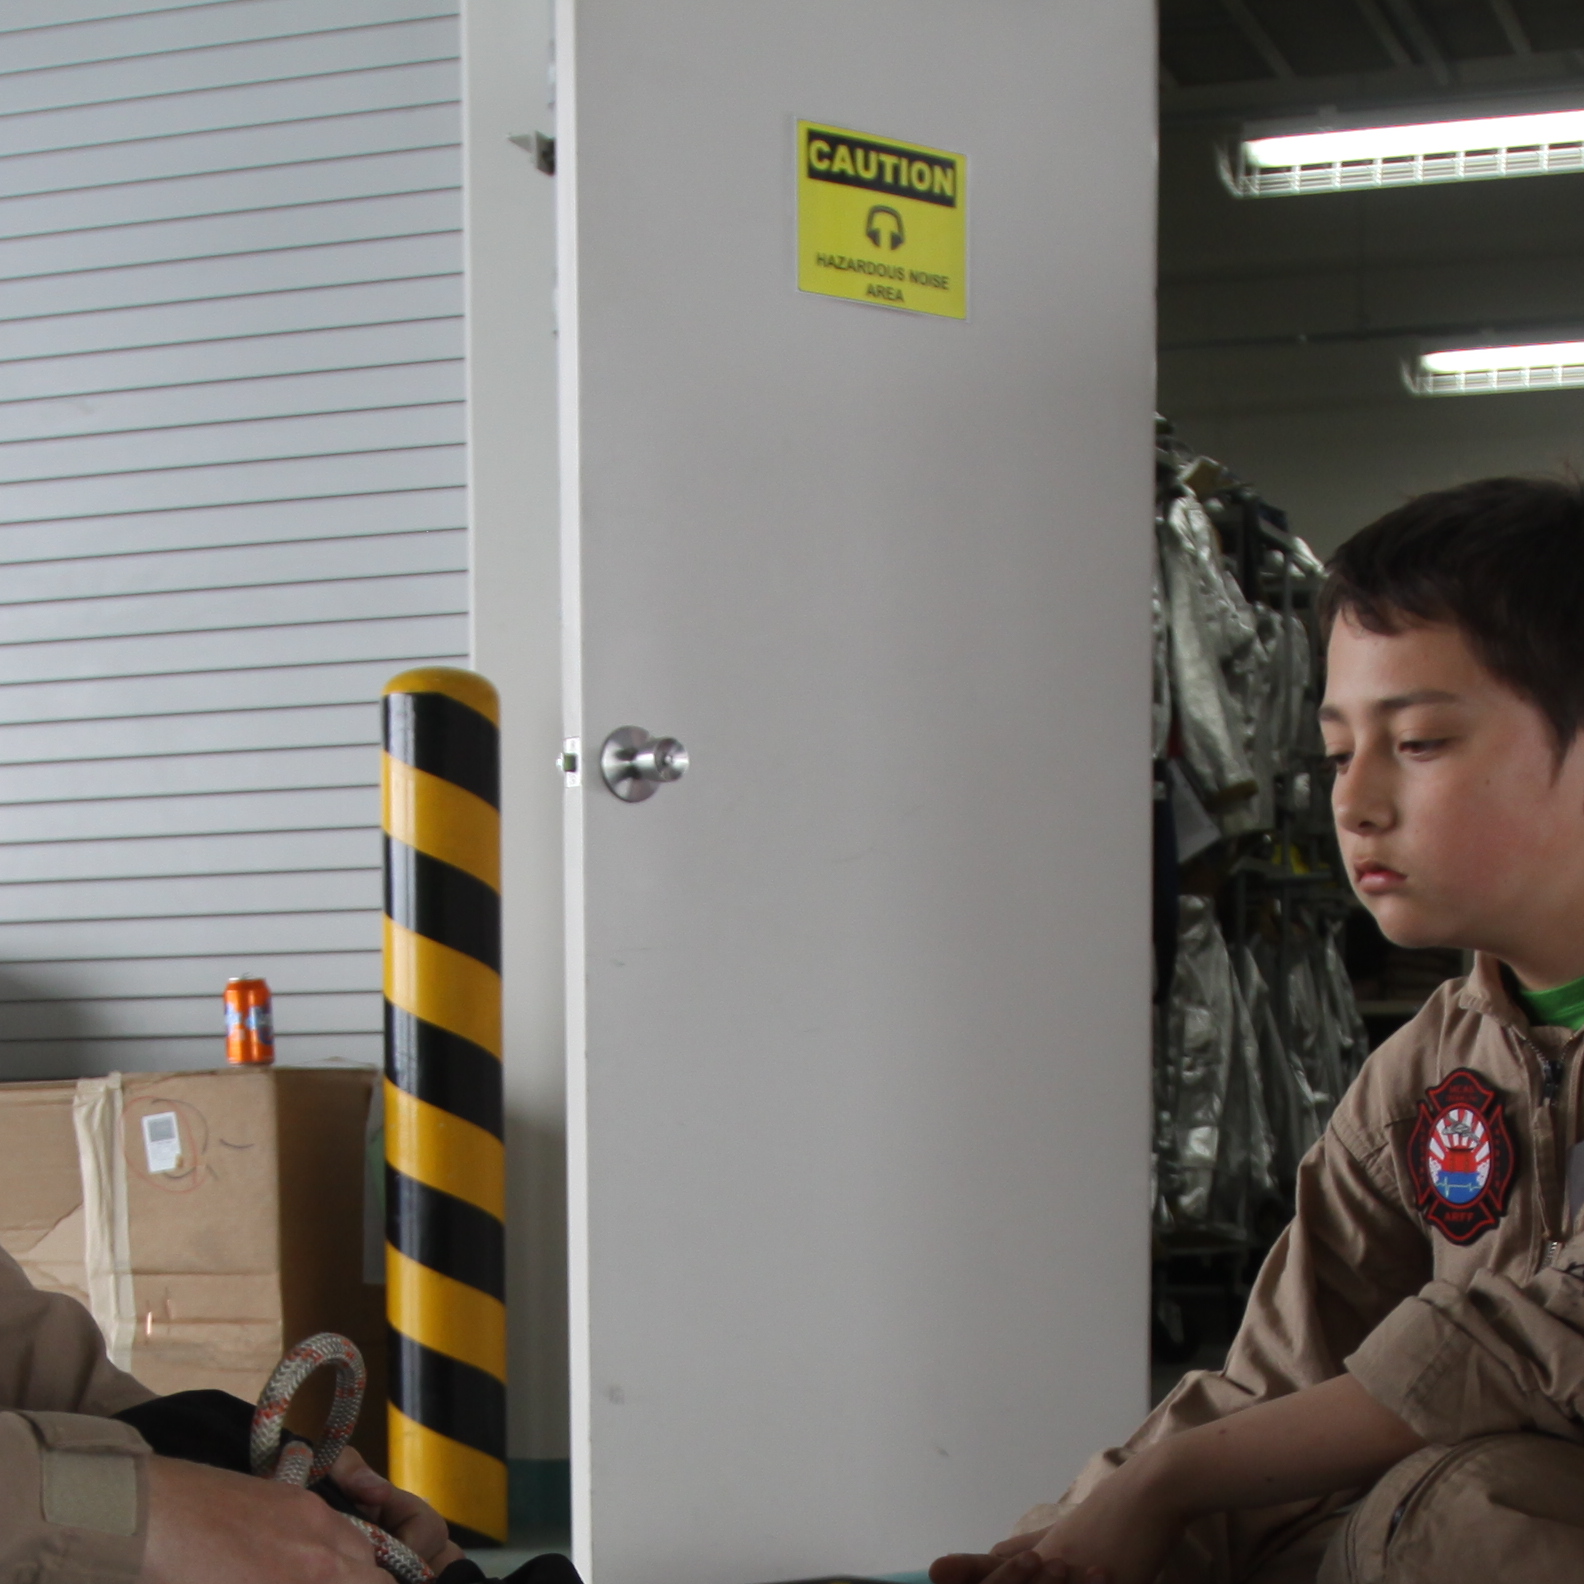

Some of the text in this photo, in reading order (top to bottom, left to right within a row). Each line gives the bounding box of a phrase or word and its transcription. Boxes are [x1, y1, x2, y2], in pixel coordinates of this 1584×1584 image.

[809, 139, 955, 197] CAUTION
[816, 252, 950, 290] HAZARDOUS NOISE
[866, 283, 905, 302] AREA
